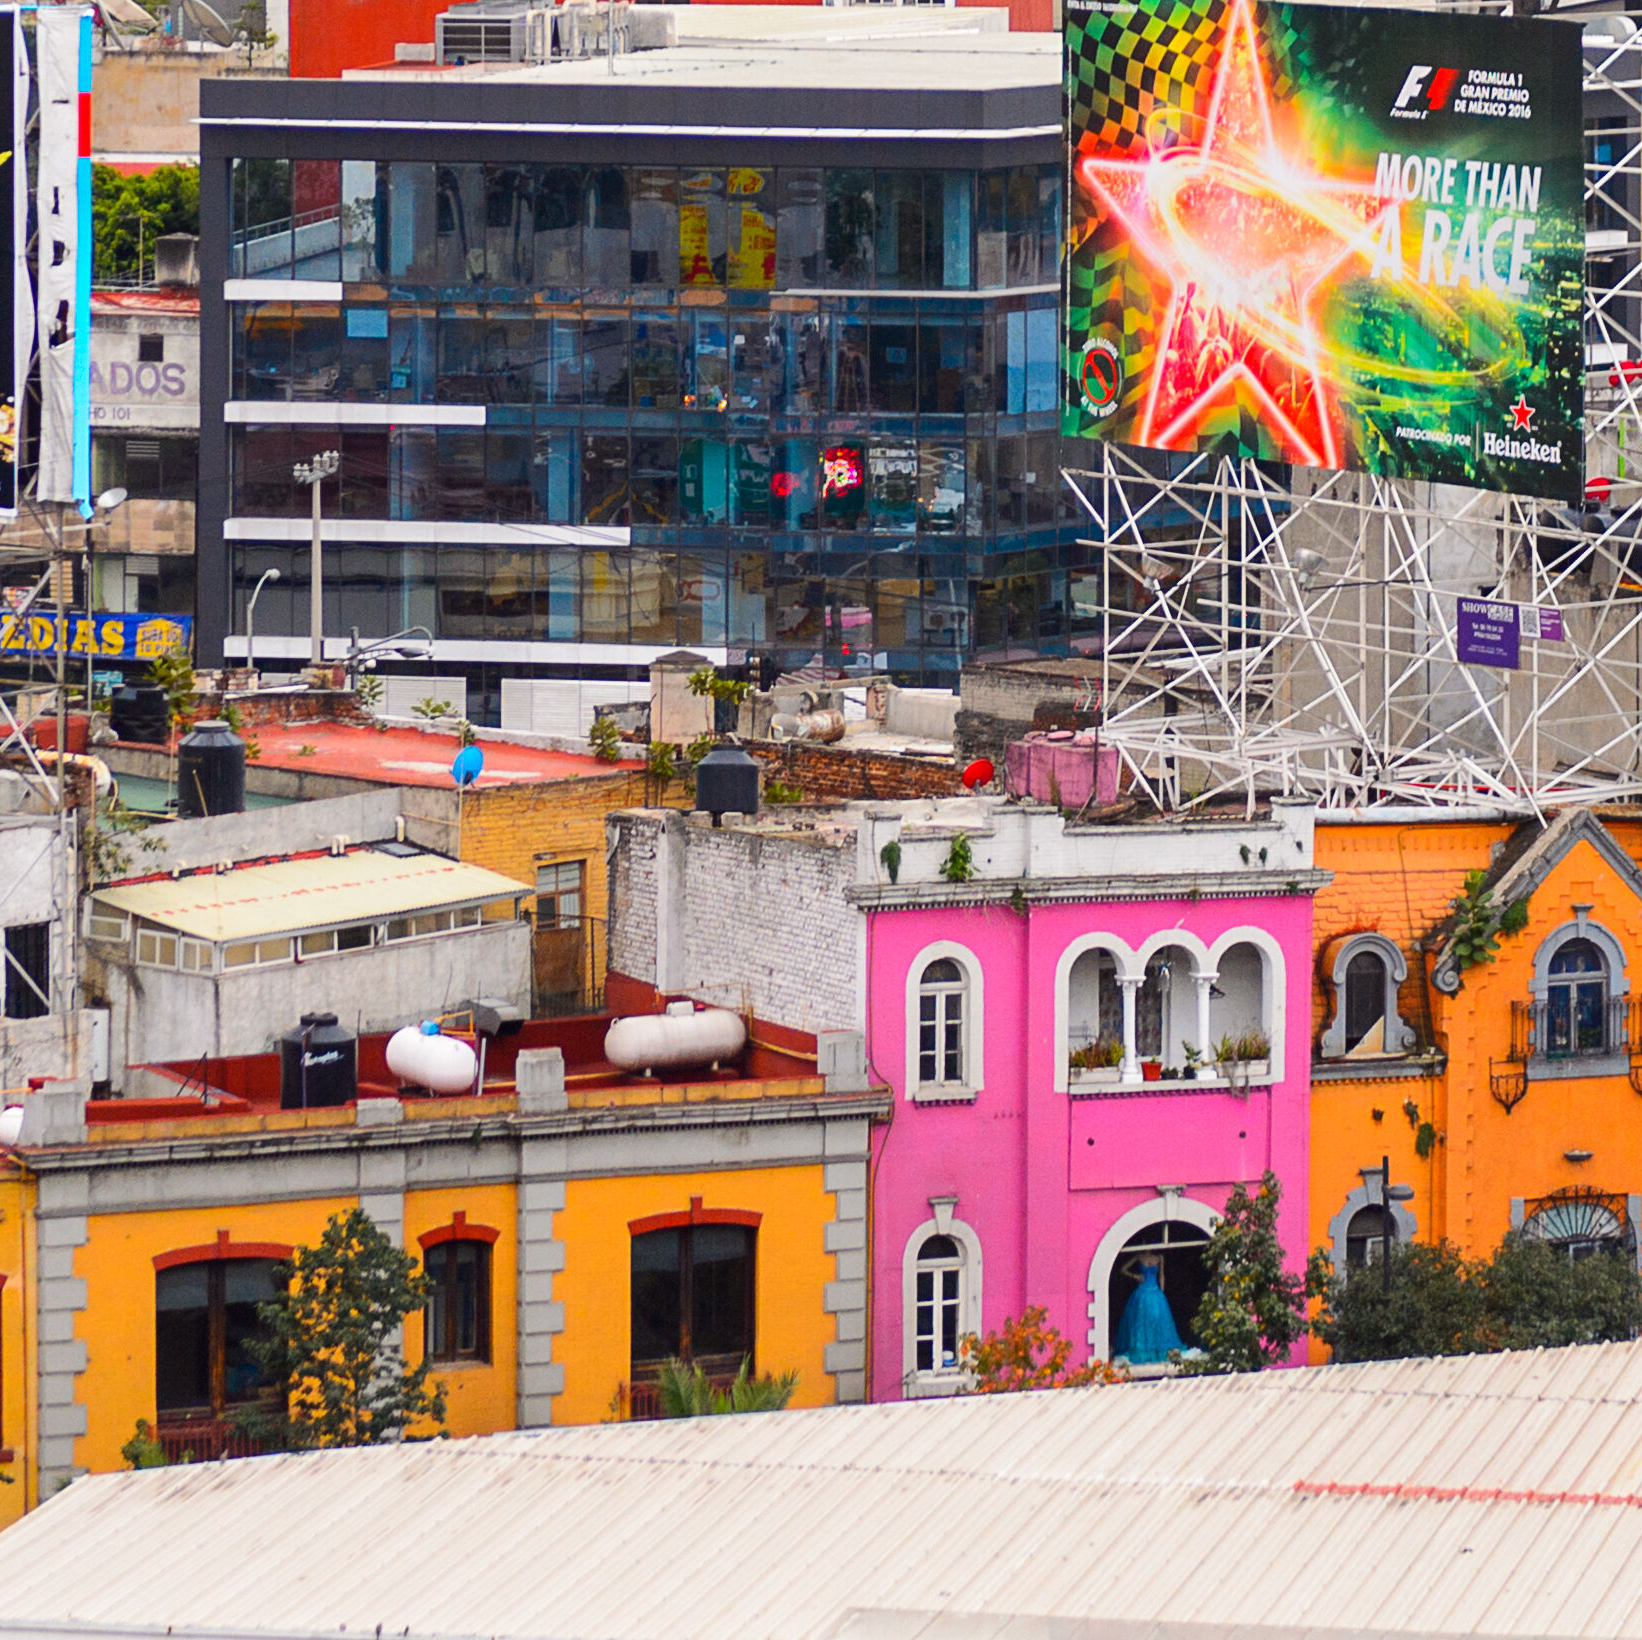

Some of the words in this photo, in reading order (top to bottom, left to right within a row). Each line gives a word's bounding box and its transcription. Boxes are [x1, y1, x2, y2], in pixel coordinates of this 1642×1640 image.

[1468, 69, 1515, 86] FORMULA
[1517, 73, 1524, 87] 1
[1460, 84, 1489, 100] GRAN
[1491, 87, 1530, 103] PREMIO
[1454, 99, 1467, 113] DE
[1468, 97, 1507, 117] MÉXICO
[1508, 103, 1531, 119] 2016
[1374, 152, 1457, 204] MORE
[1465, 160, 1542, 213] THAN
[1370, 206, 1403, 281] A
[1419, 209, 1536, 295] RACE
[1454, 434, 1472, 446] POR
[1483, 432, 1562, 464] Heineken
